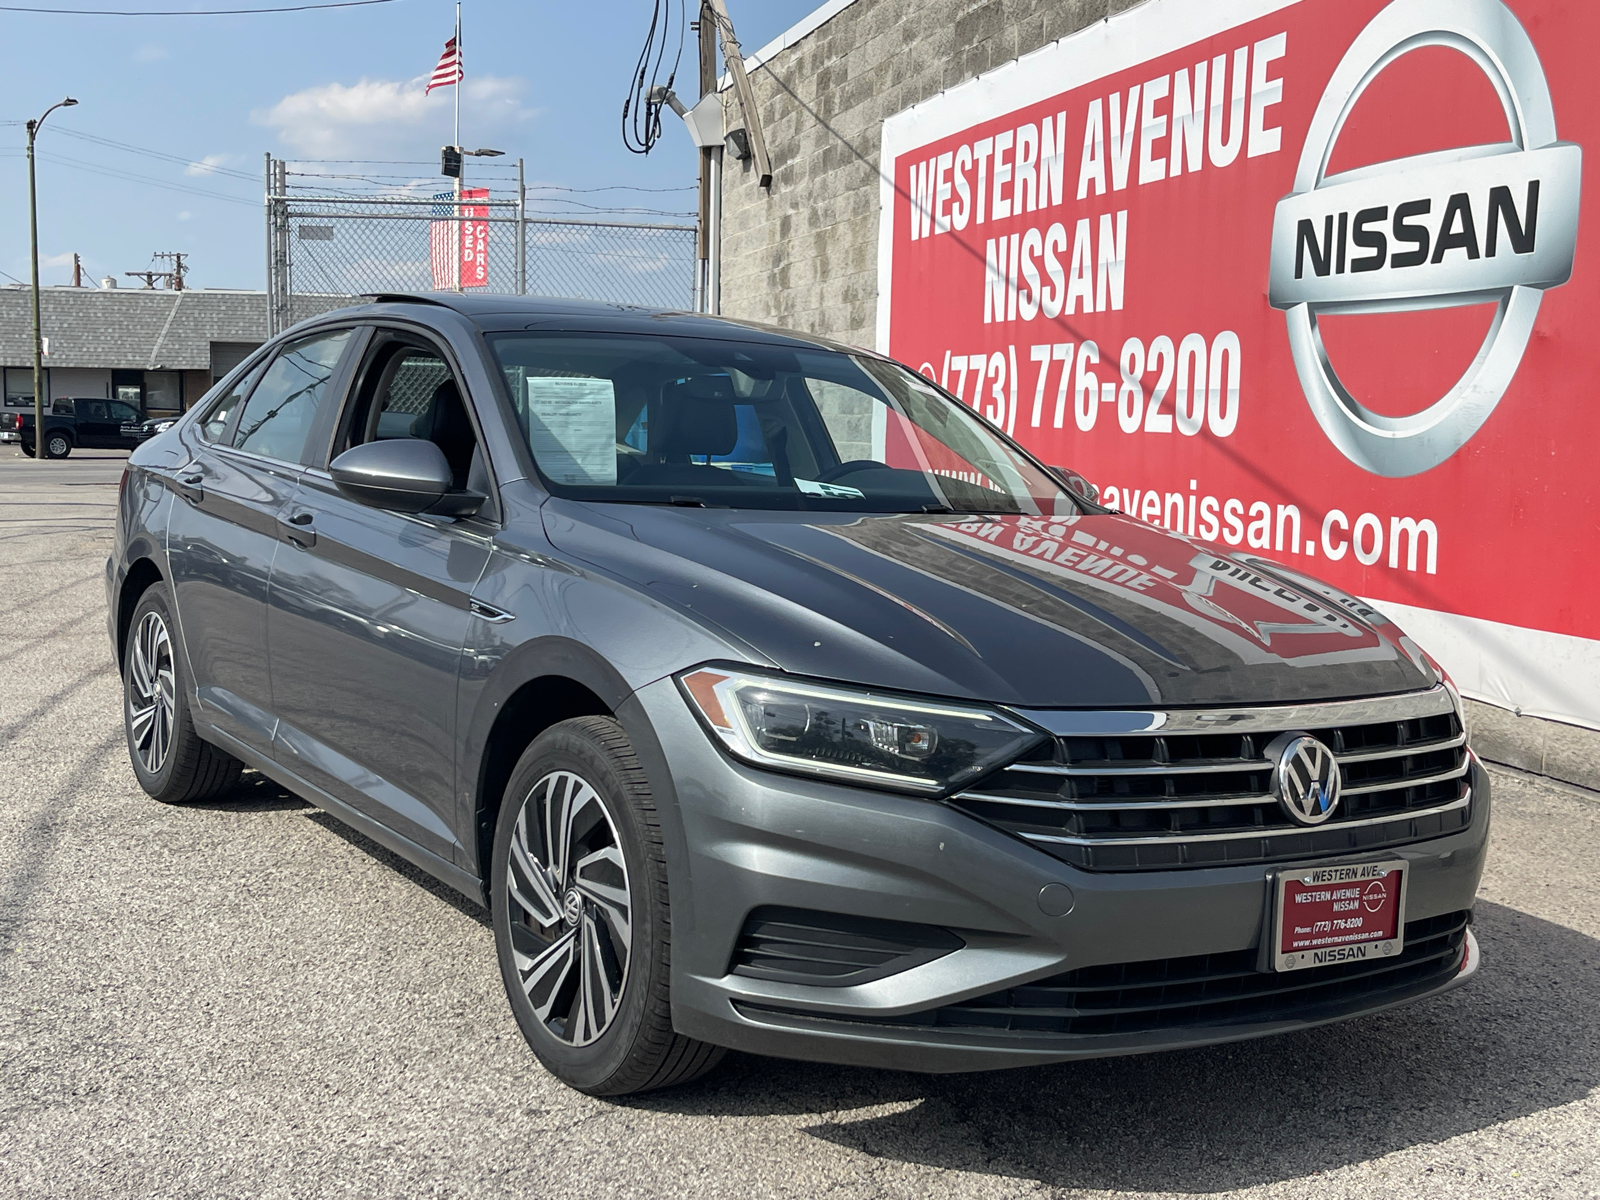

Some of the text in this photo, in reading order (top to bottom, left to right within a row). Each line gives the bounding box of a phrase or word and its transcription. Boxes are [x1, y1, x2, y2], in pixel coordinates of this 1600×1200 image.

[910, 32, 1287, 241] WESTERN AVENUE
[464, 206, 474, 262] USED
[1294, 180, 1540, 280] NISSAN
[475, 225, 486, 279] CARS
[984, 210, 1127, 323] NISSAN
[1030, 331, 1242, 438] 776-8200
[1092, 479, 1437, 574] avenissan.com
[1312, 867, 1358, 883] WESTERN
[1295, 887, 1360, 904] WESTERN AVENUE
[1333, 899, 1359, 912] NISSAN
[1363, 892, 1386, 900] NISSAN
[1293, 930, 1384, 948] www.westernavenissan.com
[1313, 921, 1331, 934] (773)
[1333, 916, 1363, 930] 776-8200
[1313, 945, 1367, 964] NISSAN
